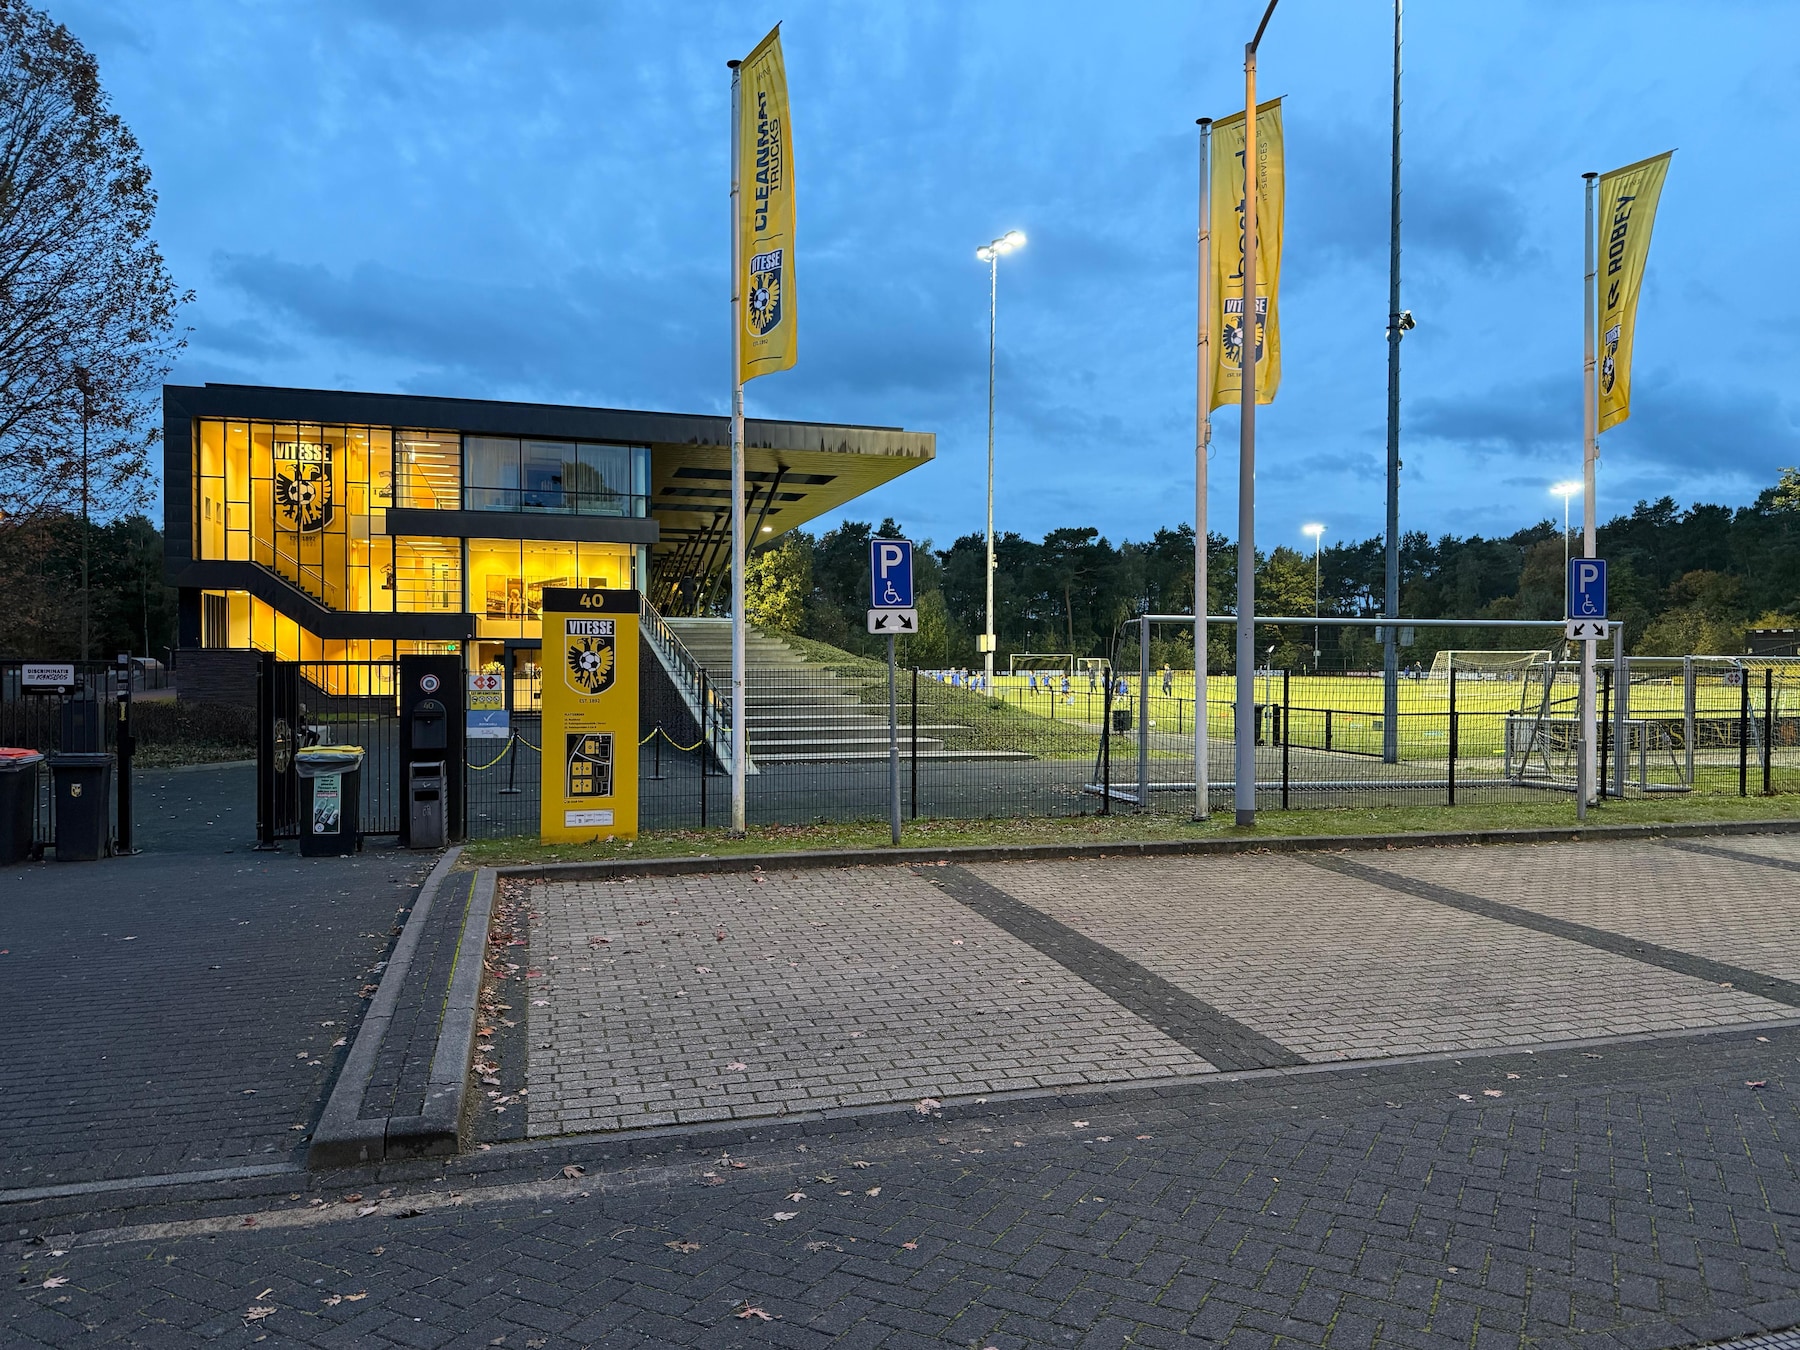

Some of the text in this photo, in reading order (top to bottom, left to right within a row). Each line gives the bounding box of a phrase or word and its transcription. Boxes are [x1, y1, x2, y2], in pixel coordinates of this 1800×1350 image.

[754, 90, 770, 232] CLEANMAT
[769, 118, 780, 194] TRUCKS
[1260, 142, 1268, 189] SERVICES
[1608, 195, 1636, 276] ROBEY
[1226, 299, 1266, 313] VITSE
[274, 442, 330, 460] VITESSE
[881, 545, 903, 579] P
[1580, 564, 1599, 593] P
[579, 593, 604, 608] 40
[569, 620, 613, 635] VITESSE
[423, 702, 434, 710] 40
